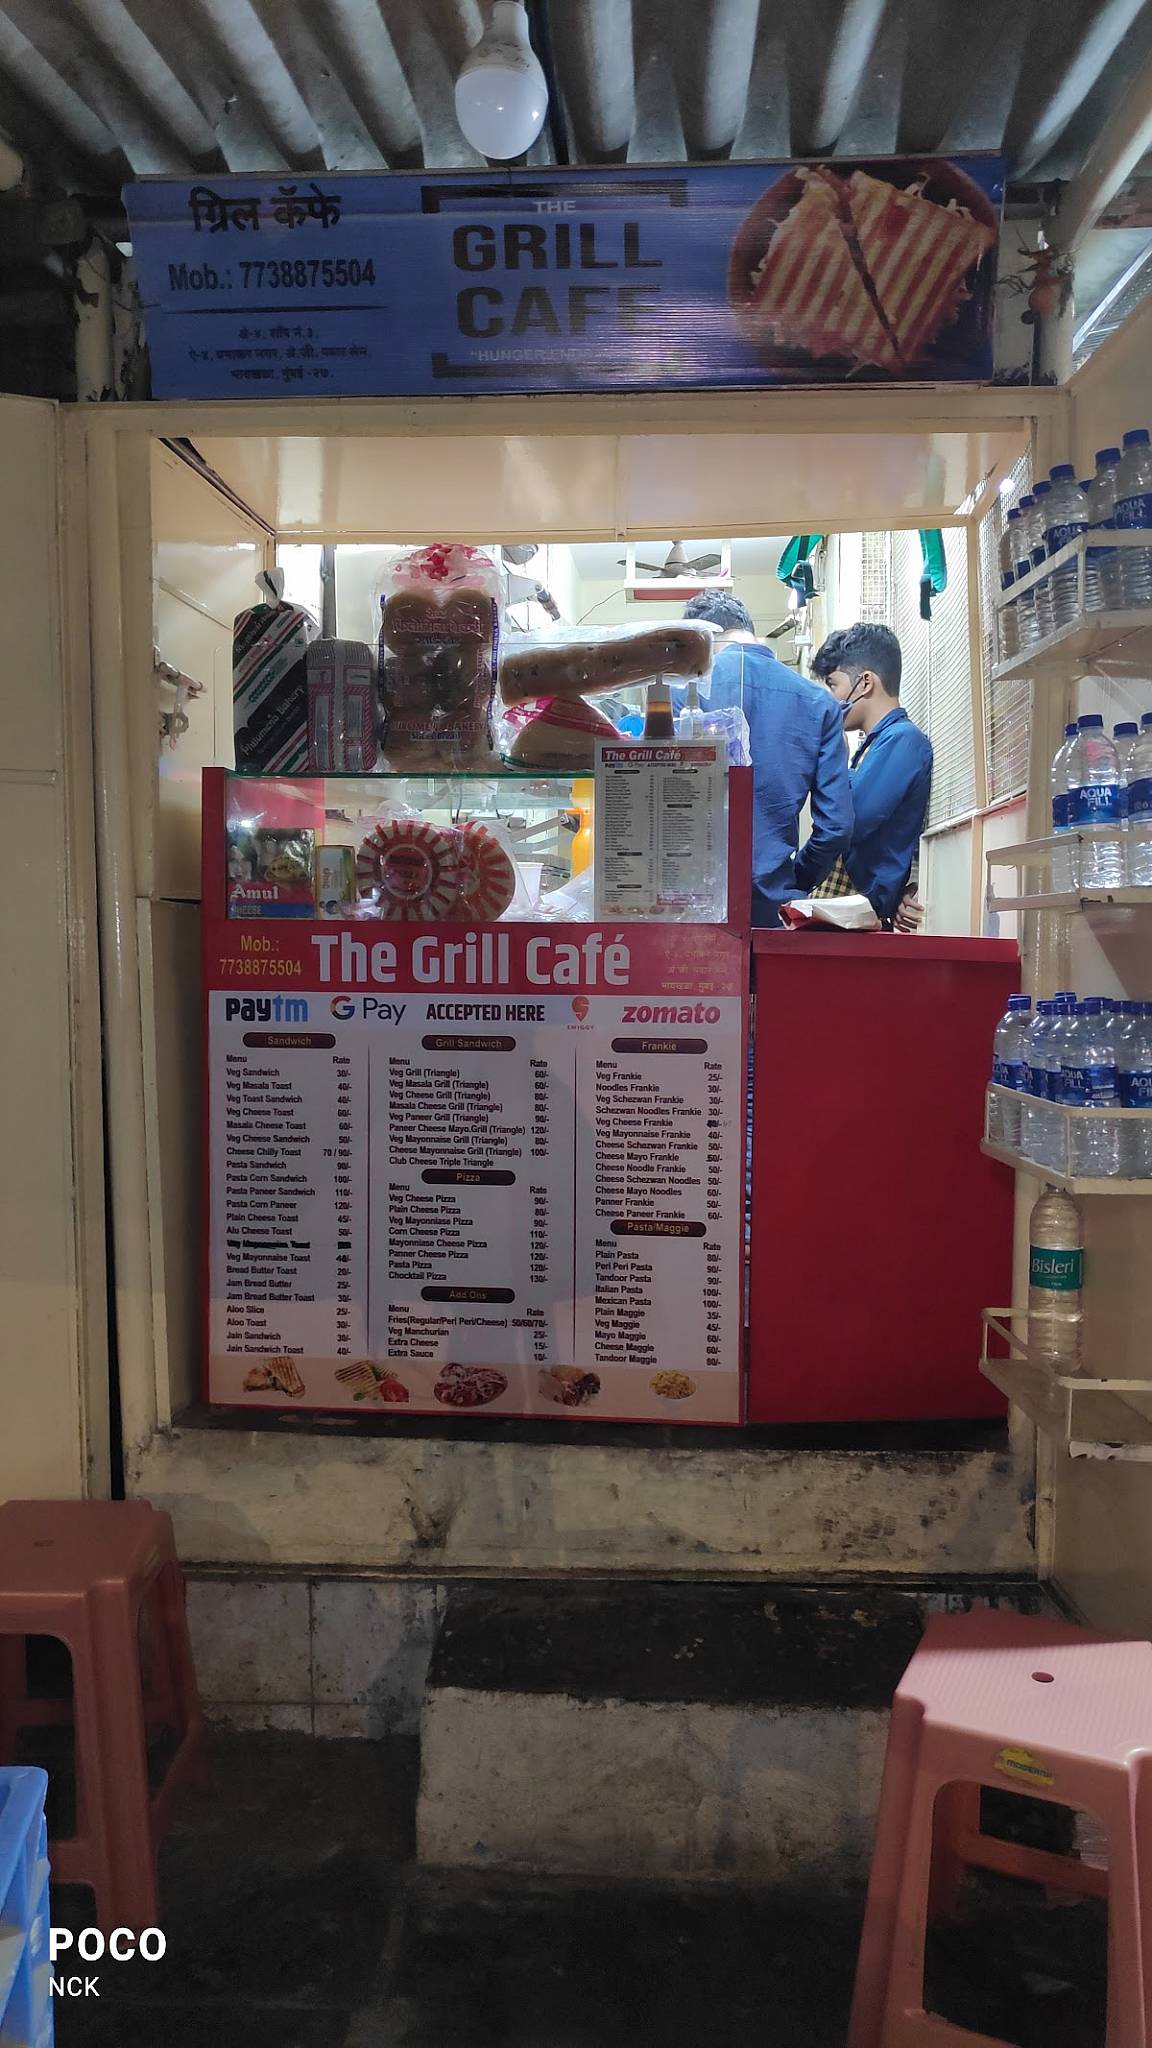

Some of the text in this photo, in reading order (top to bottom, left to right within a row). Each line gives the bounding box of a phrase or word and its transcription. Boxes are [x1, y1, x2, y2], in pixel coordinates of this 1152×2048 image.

[188, 182, 342, 233] ग्रिल कॅफे
[532, 200, 577, 215] THE
[452, 222, 664, 272] GRILL
[168, 258, 376, 291] Mob.: 7738875504
[605, 749, 681, 761] The Grill Café
[1079, 786, 1112, 799] AQUA
[1088, 797, 1112, 807] FILL
[230, 883, 279, 901] Amul
[240, 935, 280, 951] Mob.:
[311, 931, 397, 983] The
[412, 931, 509, 984] Grill
[526, 932, 630, 985] Café
[219, 959, 302, 976] 7738875504
[225, 995, 309, 1022] paytm
[363, 997, 407, 1026] Pay
[426, 1003, 545, 1022] ACCEPTED HERE
[621, 1002, 721, 1024] zomato
[268, 1036, 311, 1045] Sandwich
[436, 1039, 501, 1048] Grill Sandwich
[642, 1041, 677, 1050] Frankie
[333, 1056, 350, 1064] Rate
[389, 1057, 547, 1067] Menu Rate
[704, 1062, 722, 1070] Rate
[226, 1068, 240, 1077] Veg
[243, 1068, 279, 1076] Sandwich
[389, 1069, 403, 1077] Veg
[424, 1069, 460, 1078] (Triangle)
[596, 1072, 610, 1081] Veg
[613, 1072, 642, 1080] Frankie
[226, 1082, 240, 1091] Veg
[272, 1082, 291, 1090] Toast
[596, 1084, 628, 1092] Noodles
[630, 1084, 659, 1092] Frankie
[596, 1106, 635, 1114] Schezwan
[637, 1107, 670, 1115] Noodles
[672, 1108, 701, 1116] Frankie
[389, 1113, 403, 1121] Veg
[452, 1114, 488, 1123] (Triangle)
[226, 1161, 247, 1169] Pasta
[389, 1157, 493, 1167] Club Cheese Triple Triangle
[596, 1163, 624, 1172] Cheese
[627, 1164, 654, 1172] Noodle
[657, 1164, 686, 1173] Frankie
[226, 1174, 247, 1182] Pasta
[270, 1175, 307, 1183] Sandwich
[457, 1173, 480, 1182] Pizza
[226, 1187, 247, 1195] Pasta
[278, 1188, 315, 1196] Sandwich
[389, 1183, 547, 1194] Menu Rate
[596, 1197, 622, 1205] Panner
[625, 1198, 654, 1206] Frankie
[248, 1214, 275, 1222] Cheese
[410, 1228, 438, 1236] Cheese
[440, 1228, 460, 1236] Pizza
[596, 1239, 721, 1250] Menu Rate
[617, 1251, 639, 1259] Pasta
[389, 1260, 410, 1268] Pasta
[412, 1261, 432, 1269] Pizza
[1032, 1258, 1074, 1274] Bisleri
[389, 1272, 424, 1280] Chocktail
[427, 1272, 447, 1280] Pizza
[596, 1273, 627, 1282] Tandoor
[629, 1274, 651, 1283] Pasta
[450, 1290, 486, 1299] Add Ons
[389, 1305, 544, 1316] Menu Rate
[595, 1308, 614, 1316] Plain
[617, 1308, 645, 1318] Maggie
[595, 1319, 609, 1328] Veg
[612, 1320, 640, 1329] Maggie
[245, 1332, 281, 1340] Sandwich
[389, 1327, 402, 1336] Veg
[405, 1327, 449, 1335] Manchurian
[388, 1338, 408, 1346] Extra
[410, 1339, 438, 1347] Cheese
